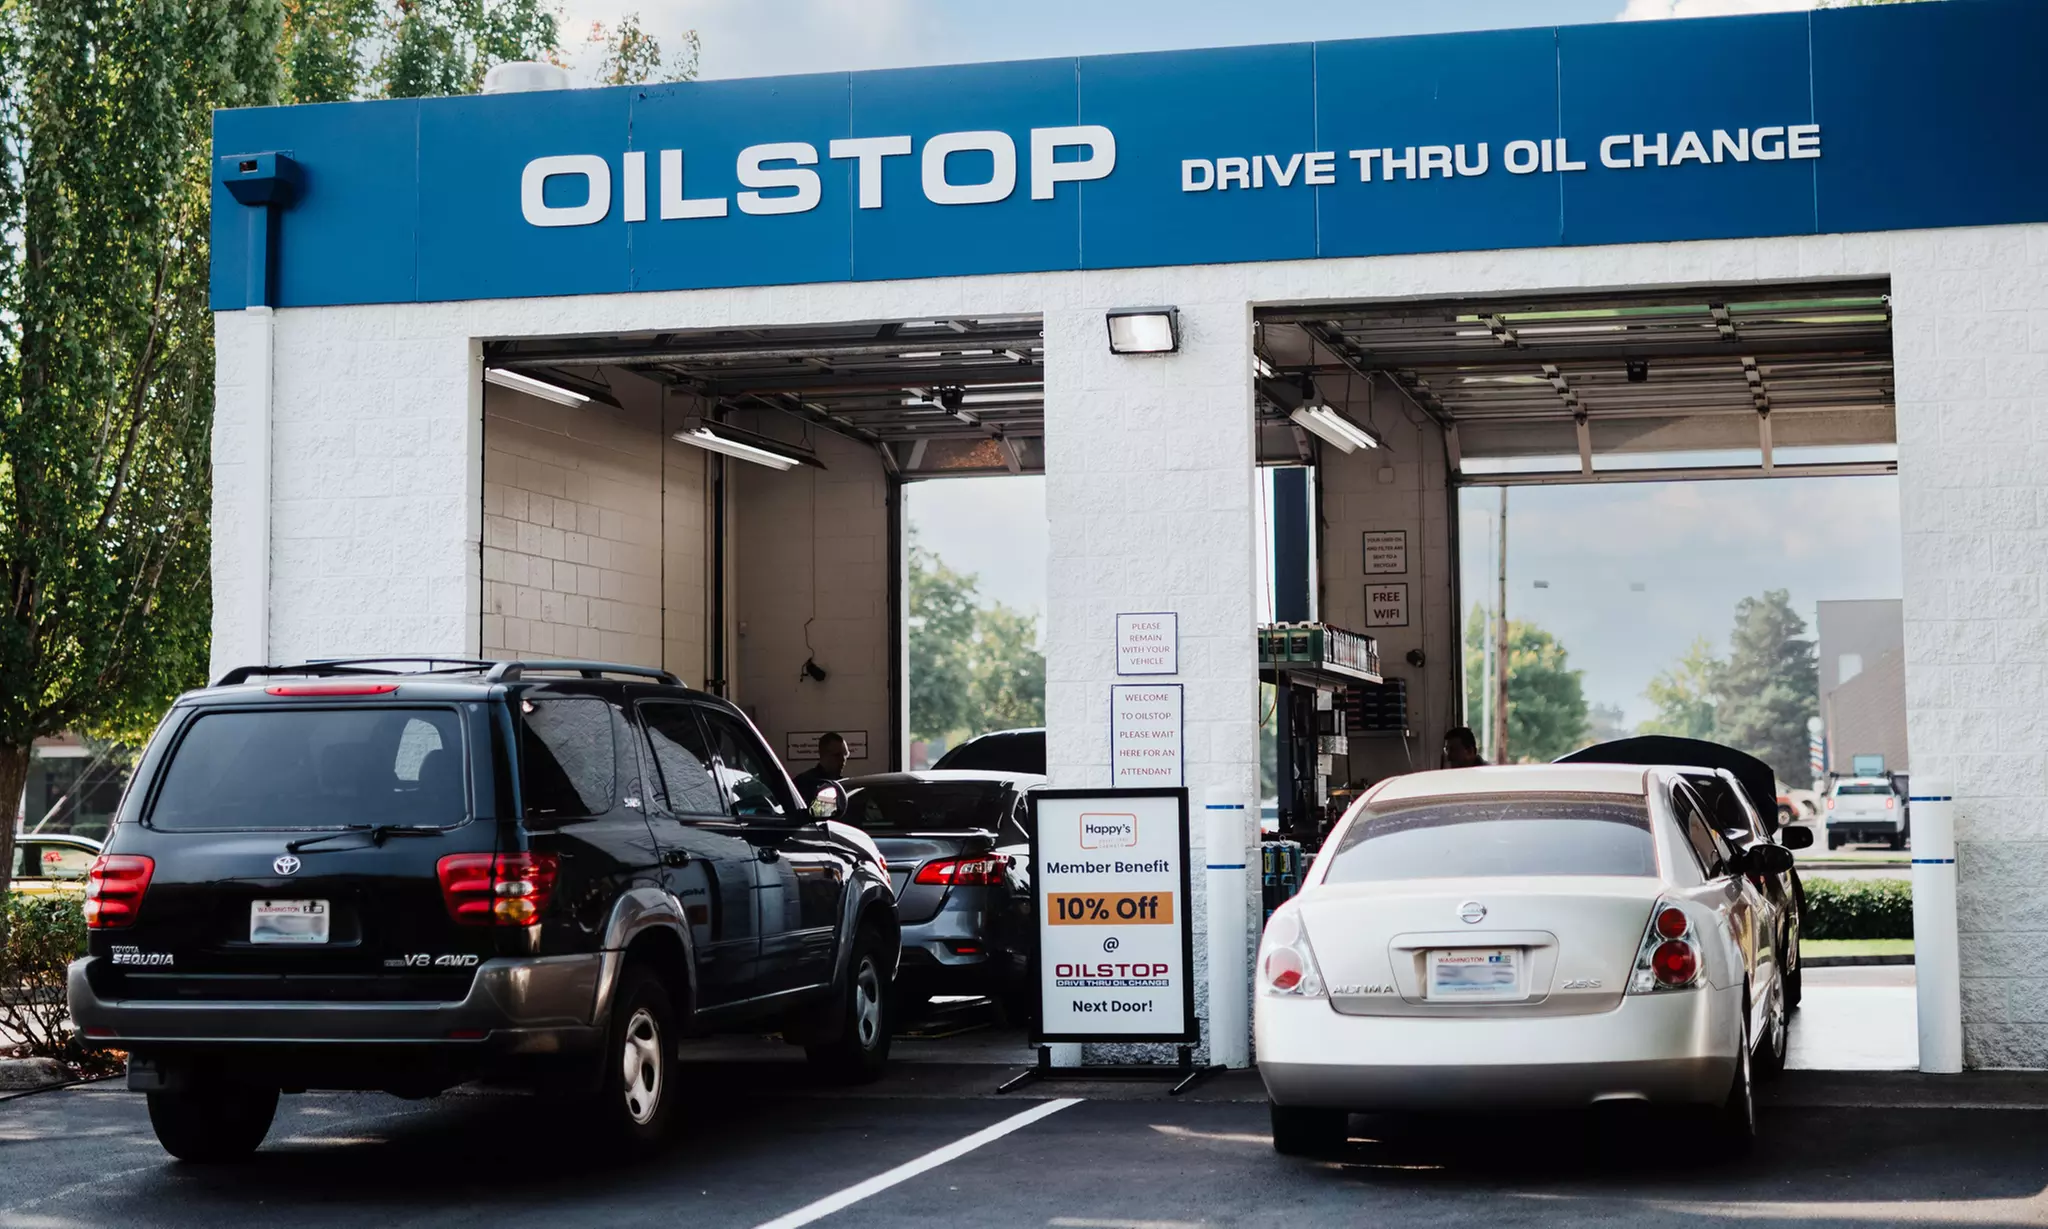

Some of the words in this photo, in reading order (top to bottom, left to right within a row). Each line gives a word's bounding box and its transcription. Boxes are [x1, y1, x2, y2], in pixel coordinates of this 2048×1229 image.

[1181, 151, 1337, 192] DRIVE
[1349, 142, 1489, 183] THRU
[1503, 137, 1587, 175] OIL
[1600, 123, 1822, 169] CHANGE
[521, 125, 1117, 228] OILSTOP
[1373, 592, 1400, 602] FREE
[1374, 609, 1400, 619] WIFI
[1129, 634, 1162, 642] REMAIN
[1130, 657, 1164, 665] VEHICLE
[1121, 712, 1133, 720] TO
[1119, 749, 1141, 757] HERE
[1143, 749, 1161, 757] FOR
[1085, 824, 1131, 835] Happy's
[1047, 862, 1111, 874] Member
[1114, 860, 1169, 873] Benefit
[1056, 897, 1110, 920] 10%
[1116, 896, 1159, 919] Off
[111, 945, 140, 954] TOYOTA
[1102, 937, 1120, 953] @
[111, 953, 174, 966] SEQUOIA
[404, 954, 431, 967] V8
[434, 954, 480, 967] 4WD
[1437, 956, 1484, 964] WASHINGTON
[1055, 963, 1169, 978] OILSTOP
[1333, 984, 1395, 995] ALTIMA
[1072, 1000, 1108, 1013] Next
[1111, 1000, 1153, 1012] Door!
